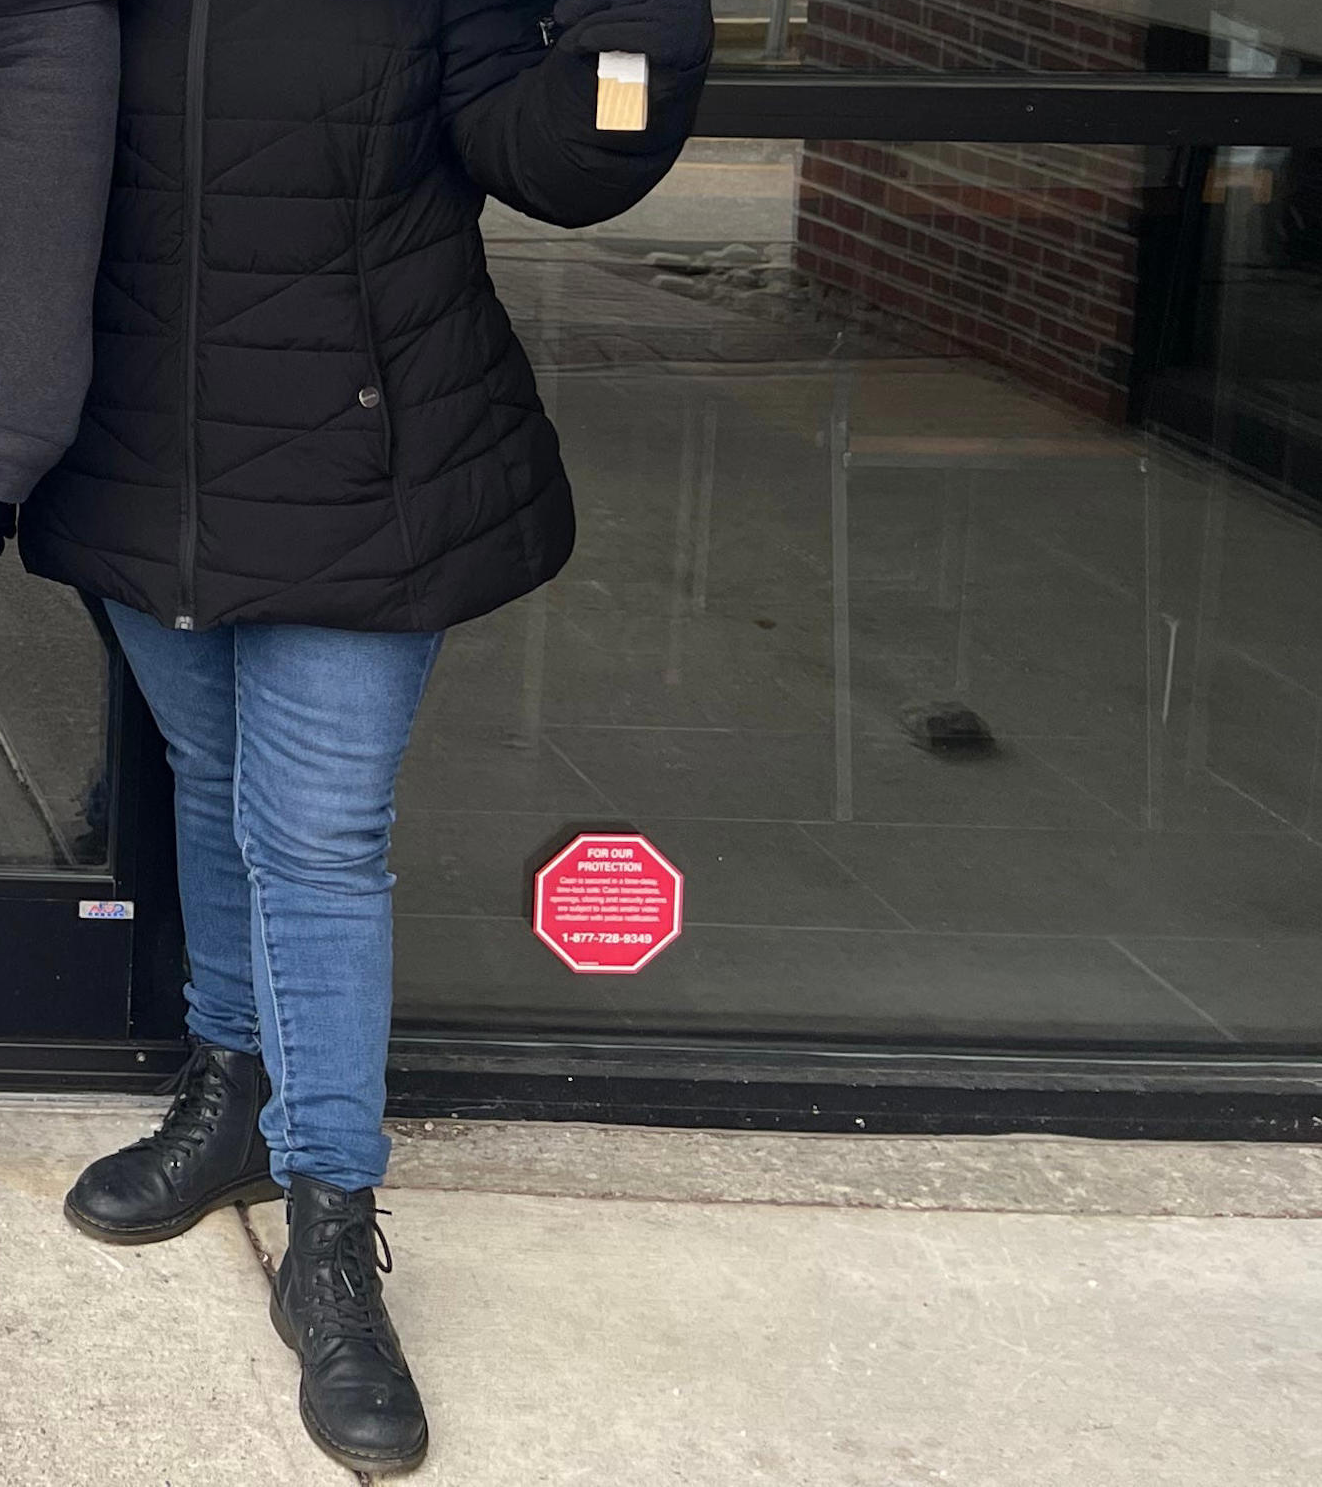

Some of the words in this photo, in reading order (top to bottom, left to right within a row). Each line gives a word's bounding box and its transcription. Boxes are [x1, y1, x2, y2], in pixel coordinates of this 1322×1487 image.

[587, 848, 608, 858] FOR
[611, 848, 633, 859] OUR
[577, 861, 642, 872] PROTECTION
[561, 932, 653, 944] 1-877-728-9349
